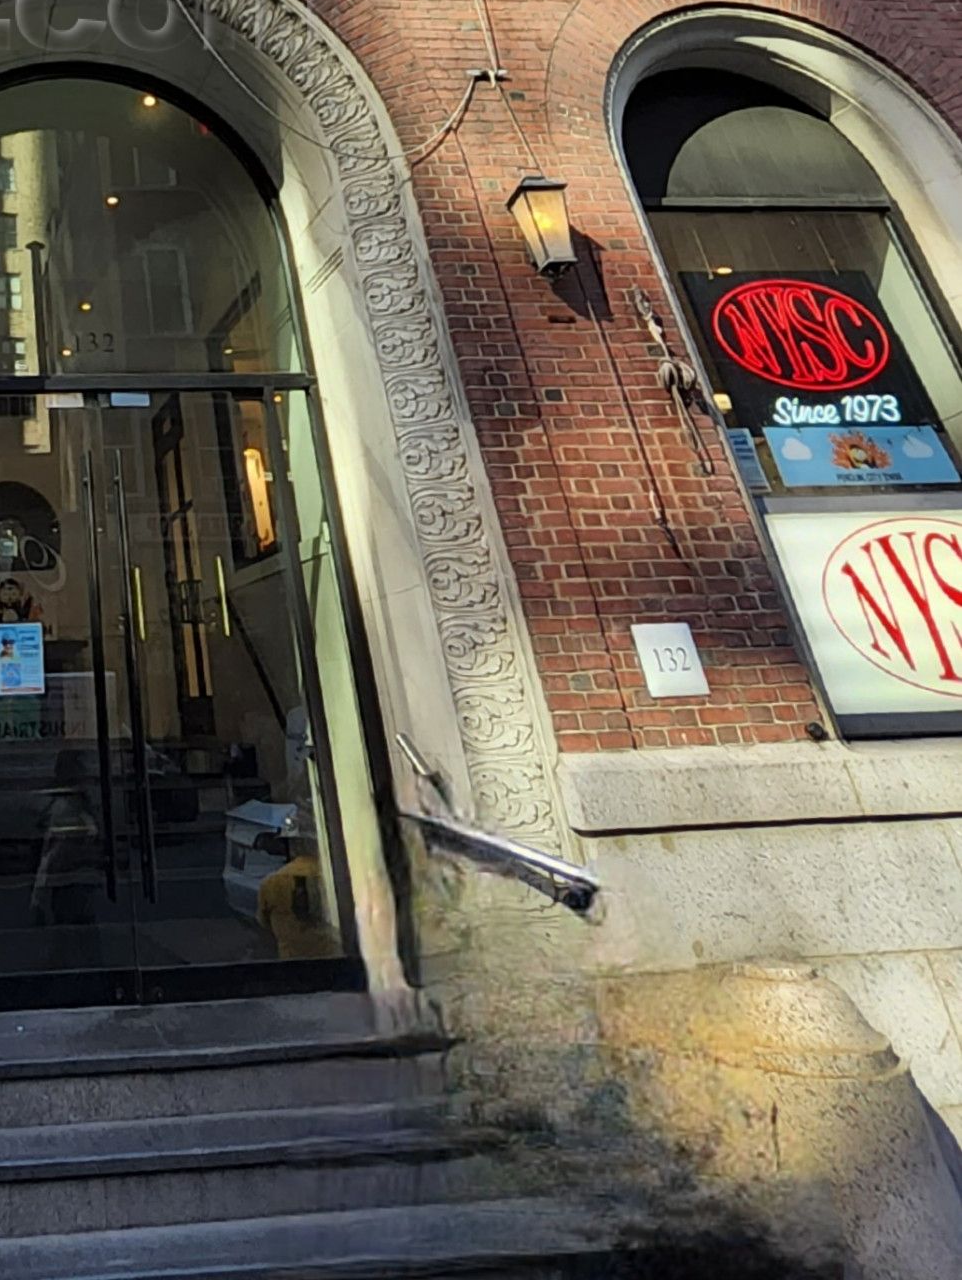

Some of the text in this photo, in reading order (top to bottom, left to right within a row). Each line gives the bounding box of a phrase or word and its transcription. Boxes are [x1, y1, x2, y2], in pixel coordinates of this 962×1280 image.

[72, 331, 116, 353] 132
[722, 284, 877, 382] NYSC
[773, 394, 901, 425] Since 1973
[652, 646, 692, 673] 132
